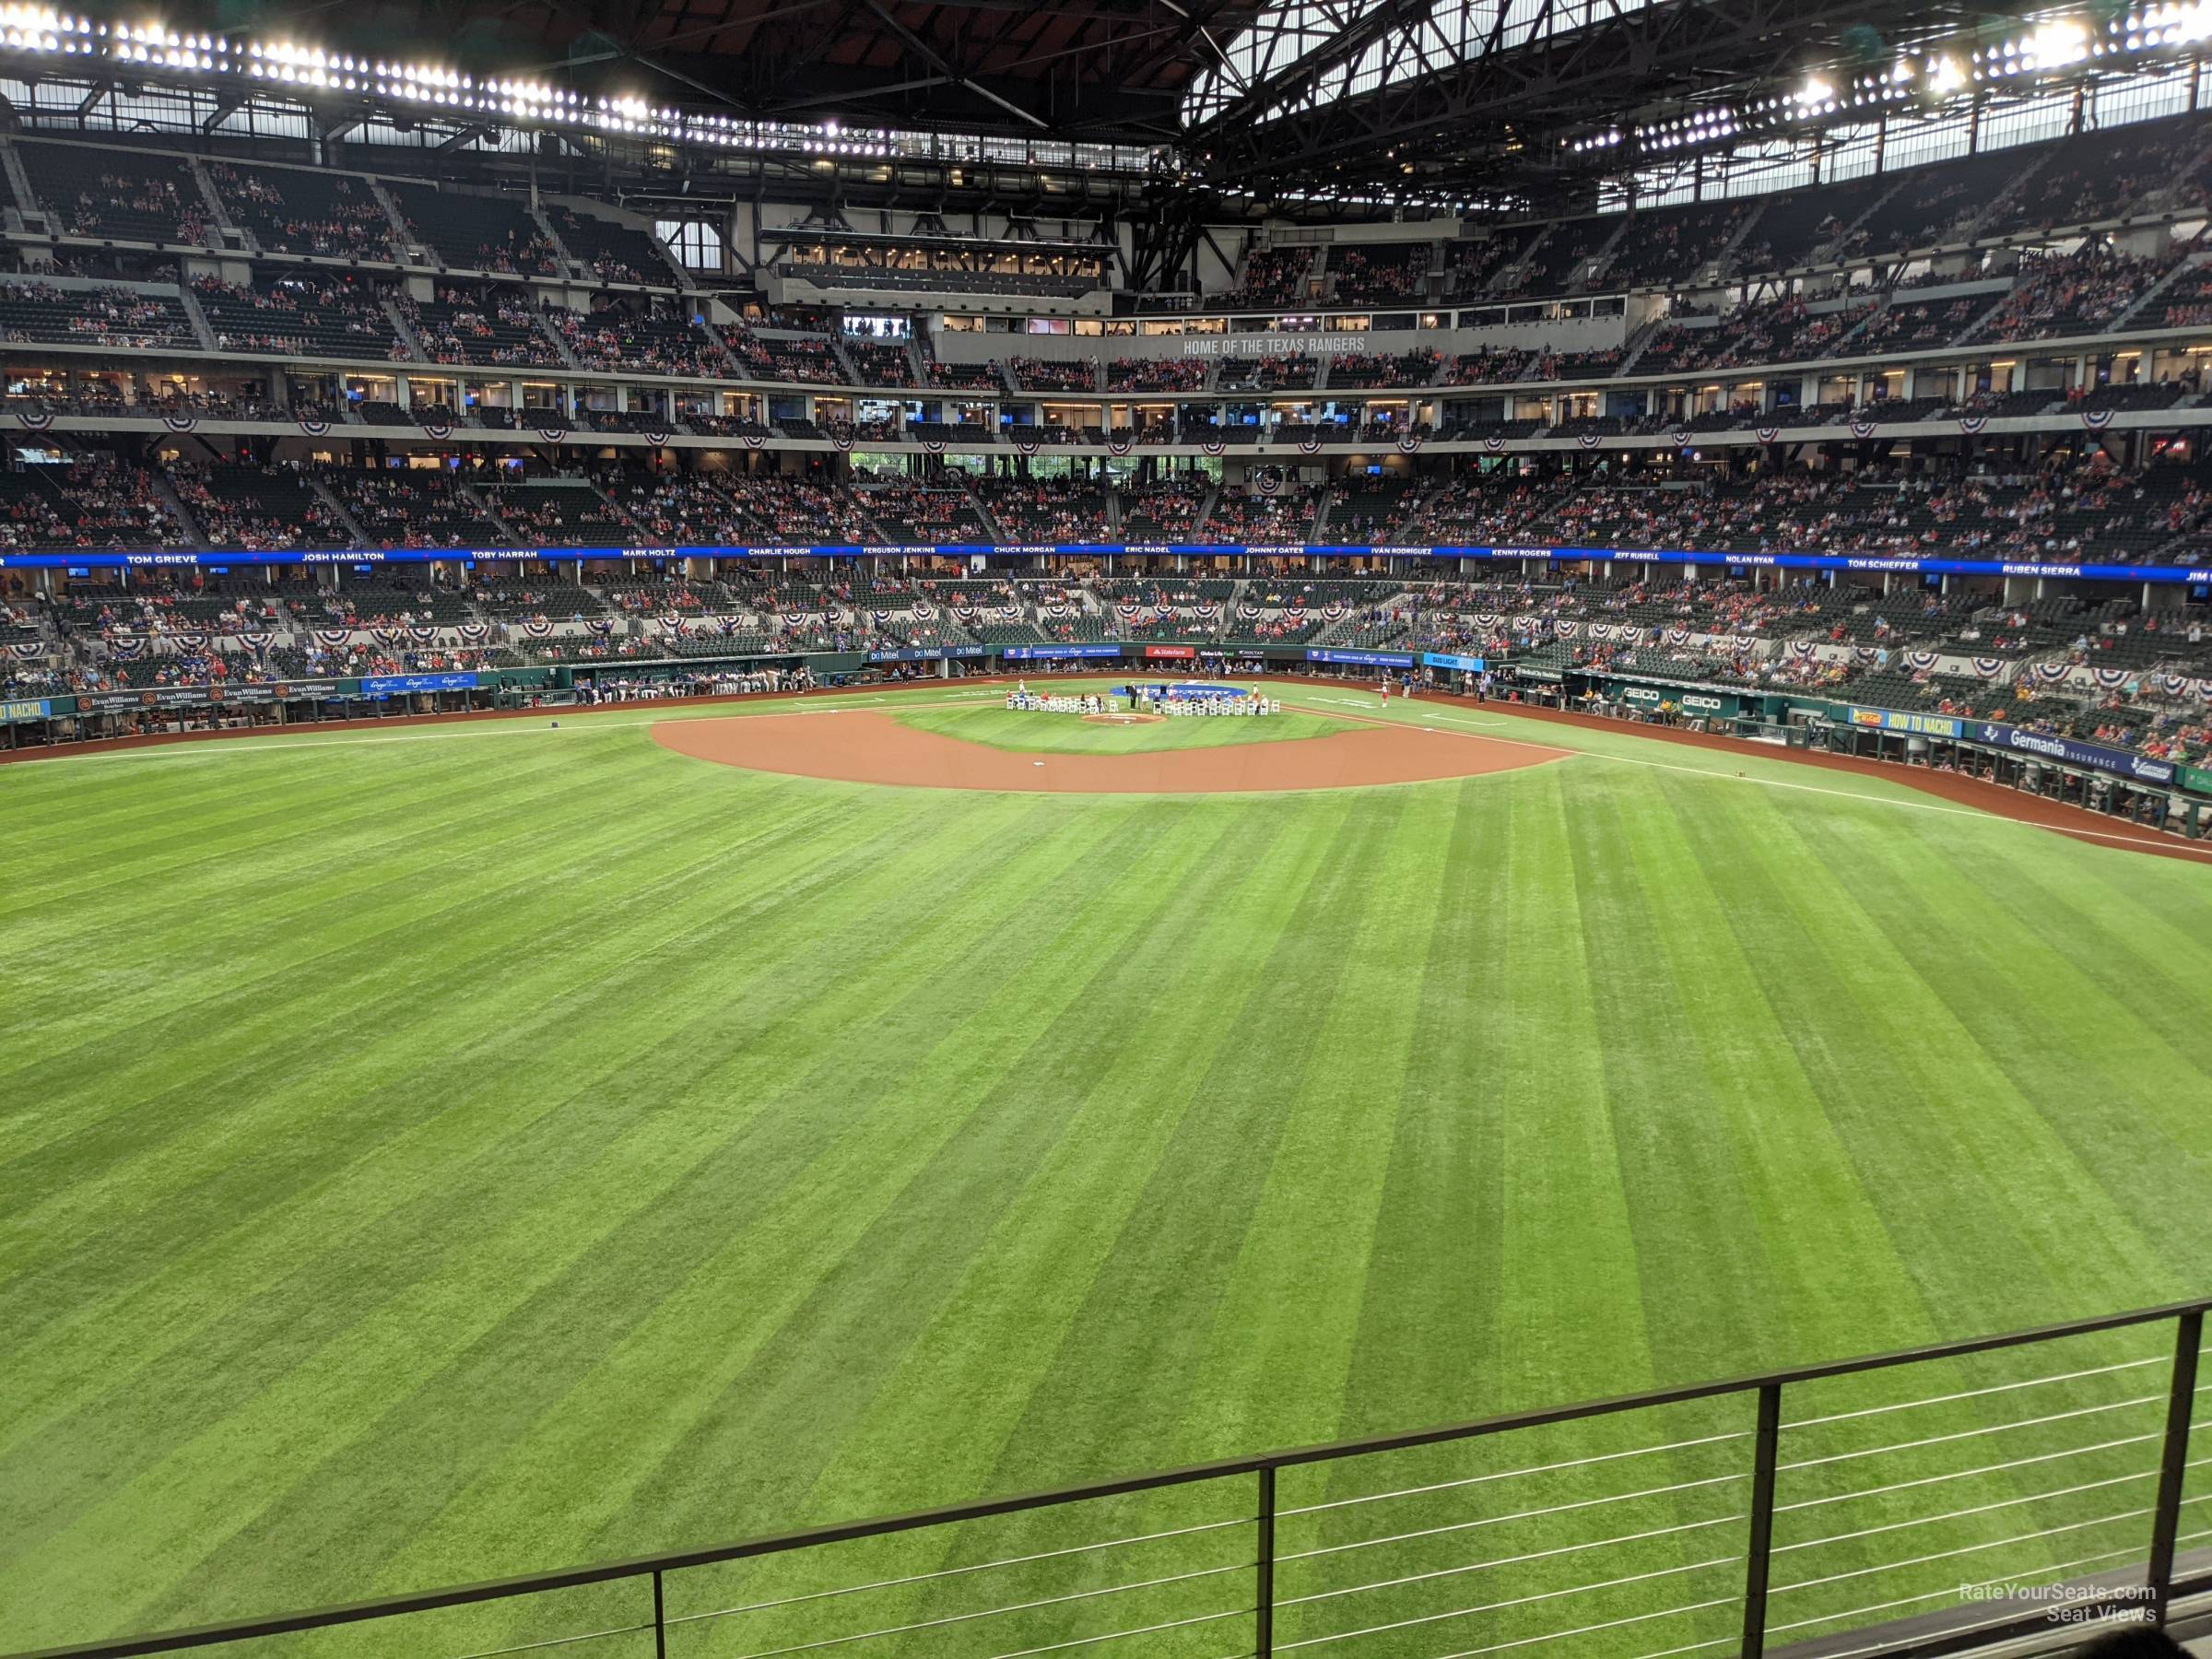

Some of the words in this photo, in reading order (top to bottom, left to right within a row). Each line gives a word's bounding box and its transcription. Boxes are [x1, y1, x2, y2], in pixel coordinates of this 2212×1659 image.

[1183, 339, 1218, 355] HOME
[1222, 339, 1238, 354] OF
[1241, 338, 1264, 353] THE
[1266, 337, 1304, 353] TEXAS
[1309, 336, 1365, 352] RANGERS
[301, 553, 330, 561] JOSH
[332, 552, 384, 560] HAMILTON
[499, 550, 537, 559] HARRAH
[1520, 549, 1551, 558] ROGERS
[1630, 552, 1660, 560] RUSSELL
[126, 556, 152, 564] TOM
[154, 555, 197, 564] GRIEVE
[1725, 555, 1753, 563] NOLAN
[1754, 556, 1774, 564] RYAN
[1847, 559, 1867, 568] TOM
[1867, 560, 1919, 570] SCHIEFFER
[2002, 564, 2040, 574] RUBEN
[2041, 566, 2080, 576] SIERRA
[2186, 571, 2208, 582] JIM
[880, 649, 900, 660] Mitel
[924, 648, 942, 657] Mitel
[965, 645, 982, 654] Mitel
[1624, 687, 1659, 701] GEICO
[1683, 694, 1722, 710] GEICO
[9, 701, 44, 719] NACHO.
[1888, 712, 1910, 729] HOW
[1912, 715, 1922, 731] TO
[1924, 717, 1954, 735] NACHO.
[2010, 729, 2065, 756] Germania
[2066, 751, 2117, 769] INSURANCE
